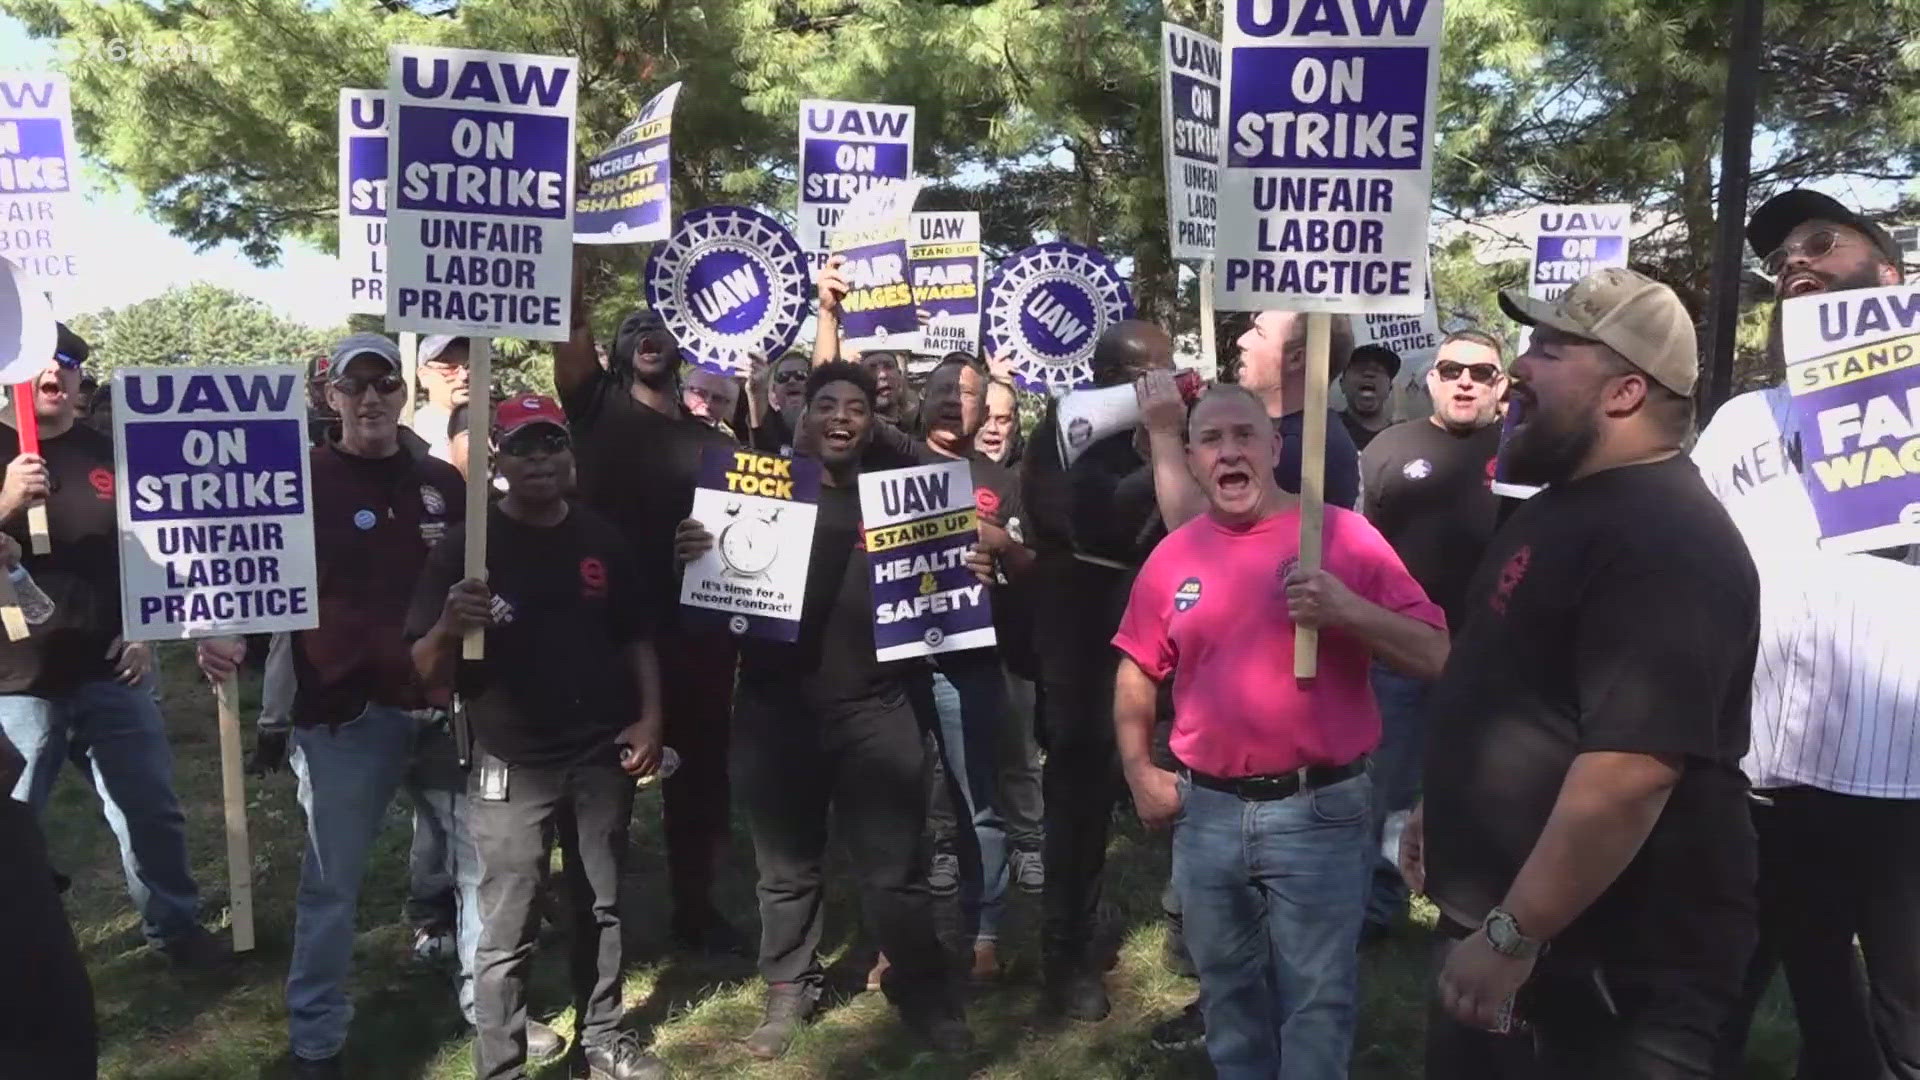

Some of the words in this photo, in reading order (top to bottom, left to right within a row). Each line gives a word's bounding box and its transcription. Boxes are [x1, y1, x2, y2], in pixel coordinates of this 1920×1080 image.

[1236, 0, 1429, 37] UAW
[1170, 32, 1221, 80] UAW
[402, 56, 571, 108] UAW
[1291, 57, 1365, 104] ON
[1192, 84, 1213, 119] ON
[452, 118, 515, 160] ON
[808, 108, 909, 137] UAW
[1234, 111, 1418, 159] STRIKE
[0, 155, 68, 190] IKE
[835, 144, 876, 173] ON
[403, 162, 562, 209] STRIKE
[590, 165, 659, 196] PROFIT
[1185, 163, 1218, 194] UNFAI
[1254, 177, 1394, 212] UNFAIR
[0, 200, 54, 222] AIR
[1188, 194, 1217, 220] LABO
[1540, 213, 1622, 231] UAW
[0, 229, 51, 250] BOR
[421, 219, 543, 254] UNFAIR
[920, 217, 965, 240] UAW
[1179, 220, 1216, 248] PRACT
[1258, 219, 1384, 253] LABOR
[913, 247, 953, 257] STAND
[1562, 239, 1597, 259] ON
[426, 255, 536, 289] LABOR
[914, 264, 974, 287] FAIR
[1226, 259, 1412, 295] PRACTICE
[1537, 260, 1591, 281] STRI
[400, 289, 562, 326] PRACTICE
[693, 263, 760, 323] UAW
[840, 282, 912, 313] WAGES
[912, 283, 976, 305] WAGES
[1027, 289, 1088, 345] UAW
[1370, 320, 1421, 340] LABOR
[924, 338, 974, 351] RACTICE
[1375, 333, 1436, 353] ACTICE
[1803, 344, 1914, 386] STAND
[124, 375, 296, 414] UAW
[1817, 387, 1920, 455] FAI
[182, 428, 247, 467] ON
[734, 452, 792, 478] TICK
[1811, 437, 1920, 492] WAG
[135, 471, 299, 512] STRIKE
[725, 471, 794, 499] TOCK
[880, 472, 949, 516] UAW
[157, 522, 284, 555] UNFAIR
[874, 521, 939, 548] STAND
[944, 515, 969, 531] UP
[166, 556, 280, 589] LABOR
[140, 587, 308, 625] PRACTICE
[691, 591, 733, 606] record
[724, 580, 752, 596] time
[756, 586, 775, 599] for
[777, 591, 785, 600] a
[876, 584, 983, 625] SAFETY
